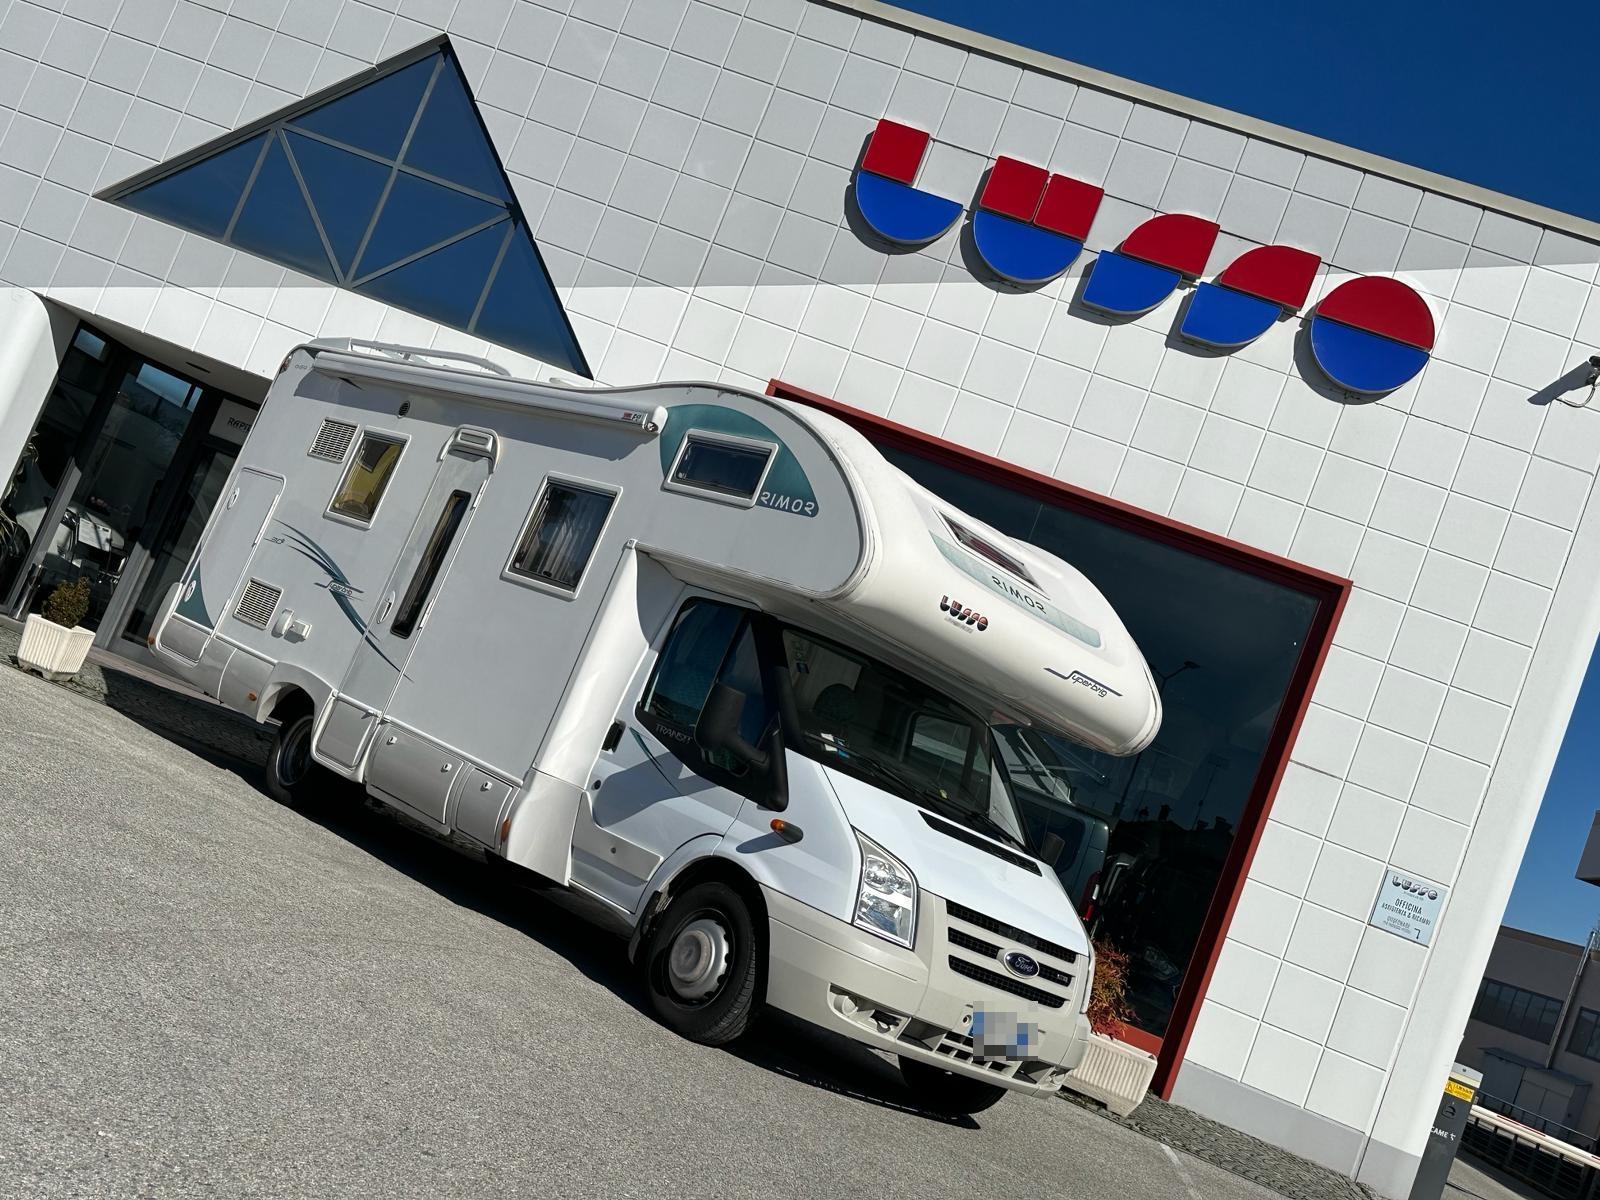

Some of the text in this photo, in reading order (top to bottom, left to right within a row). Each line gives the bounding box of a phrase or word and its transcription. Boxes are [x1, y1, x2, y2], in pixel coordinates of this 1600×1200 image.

[761, 491, 815, 515] RIMOR
[991, 575, 1047, 615] RIMOR
[1394, 898, 1422, 915] OFFICINA
[1014, 956, 1035, 973] Ford
